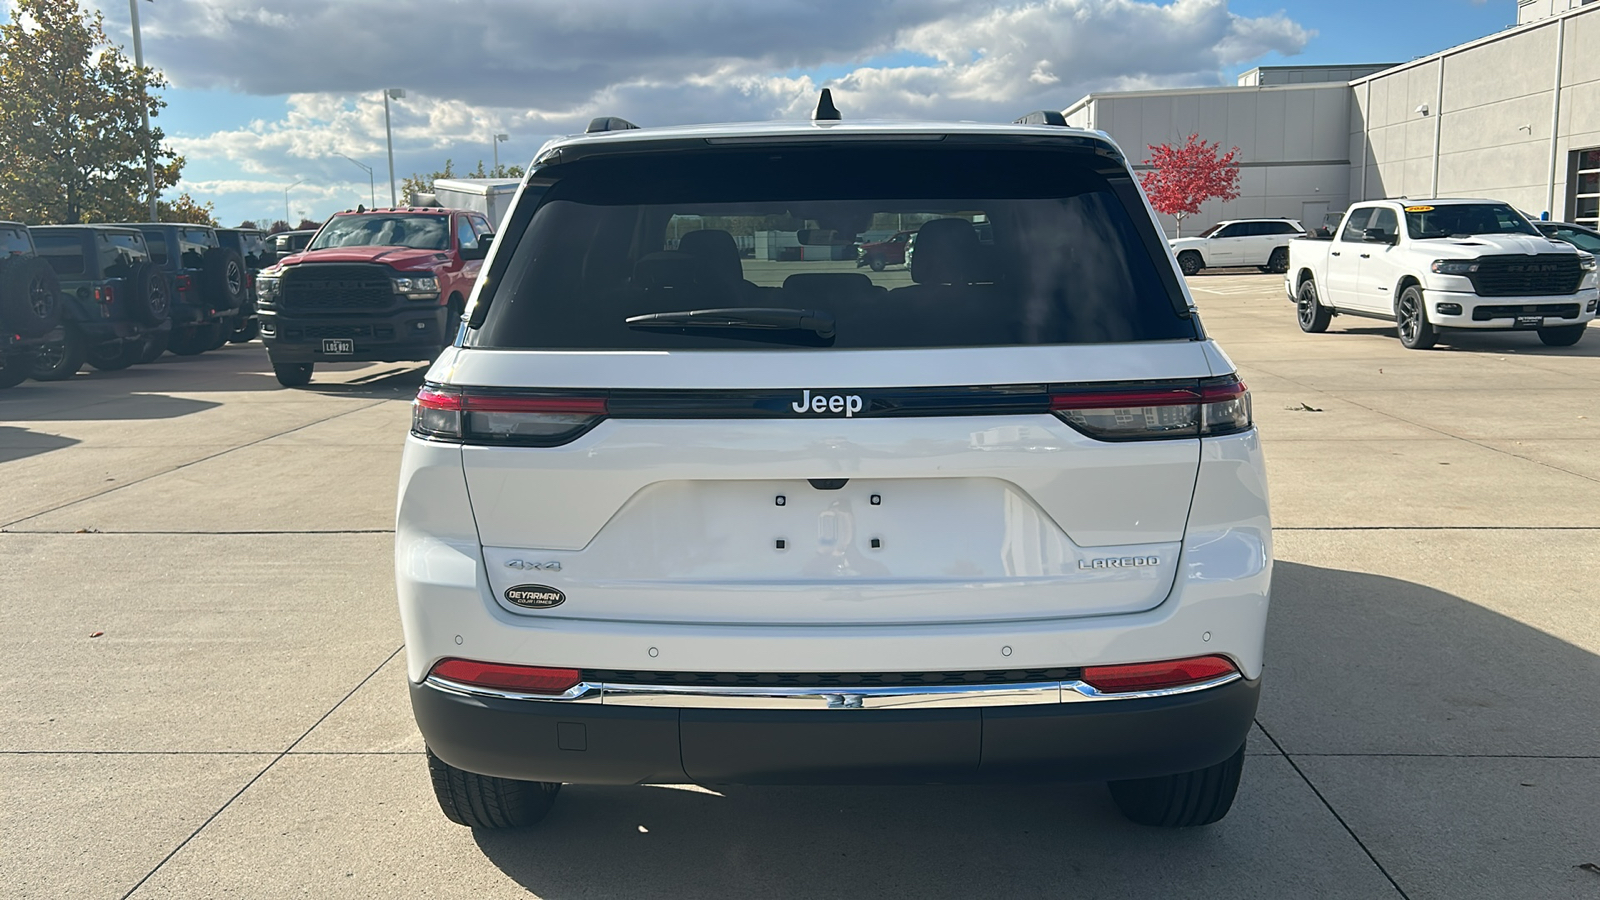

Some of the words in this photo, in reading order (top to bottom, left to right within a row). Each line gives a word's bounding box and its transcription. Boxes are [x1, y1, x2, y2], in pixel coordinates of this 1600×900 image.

[792, 389, 863, 417] Jeep
[504, 559, 562, 572] 4x4
[1078, 556, 1160, 569] LAREDO
[508, 591, 560, 600] DEYARMAN
